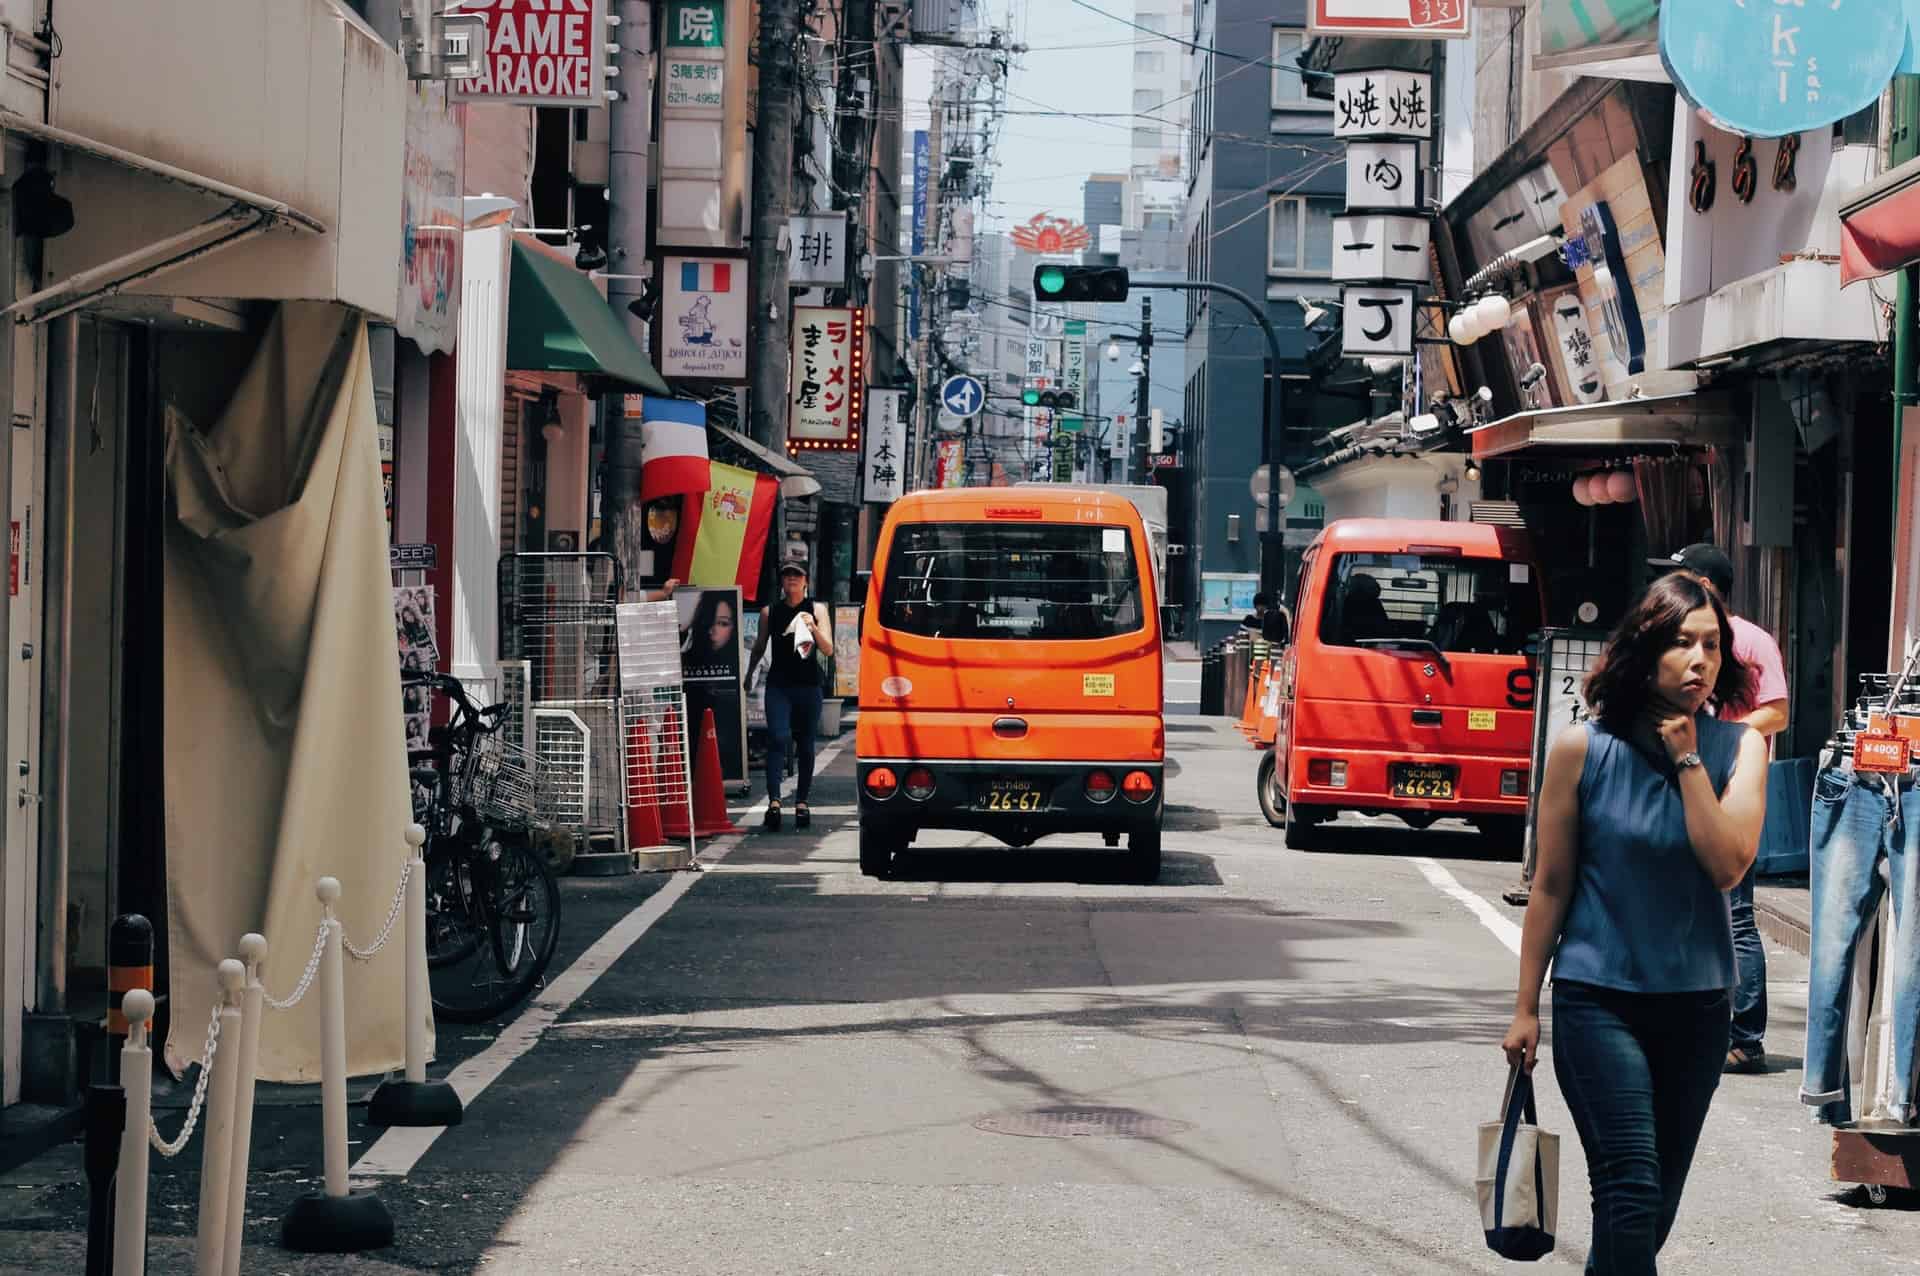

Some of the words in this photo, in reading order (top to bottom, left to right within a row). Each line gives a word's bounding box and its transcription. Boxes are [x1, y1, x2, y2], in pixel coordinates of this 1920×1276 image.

[679, 7, 714, 41] 院
[795, 324, 822, 409] まこと屋
[823, 321, 847, 413] ラーメン
[989, 792, 1041, 810] 26-67
[1406, 779, 1452, 796] 66-29
